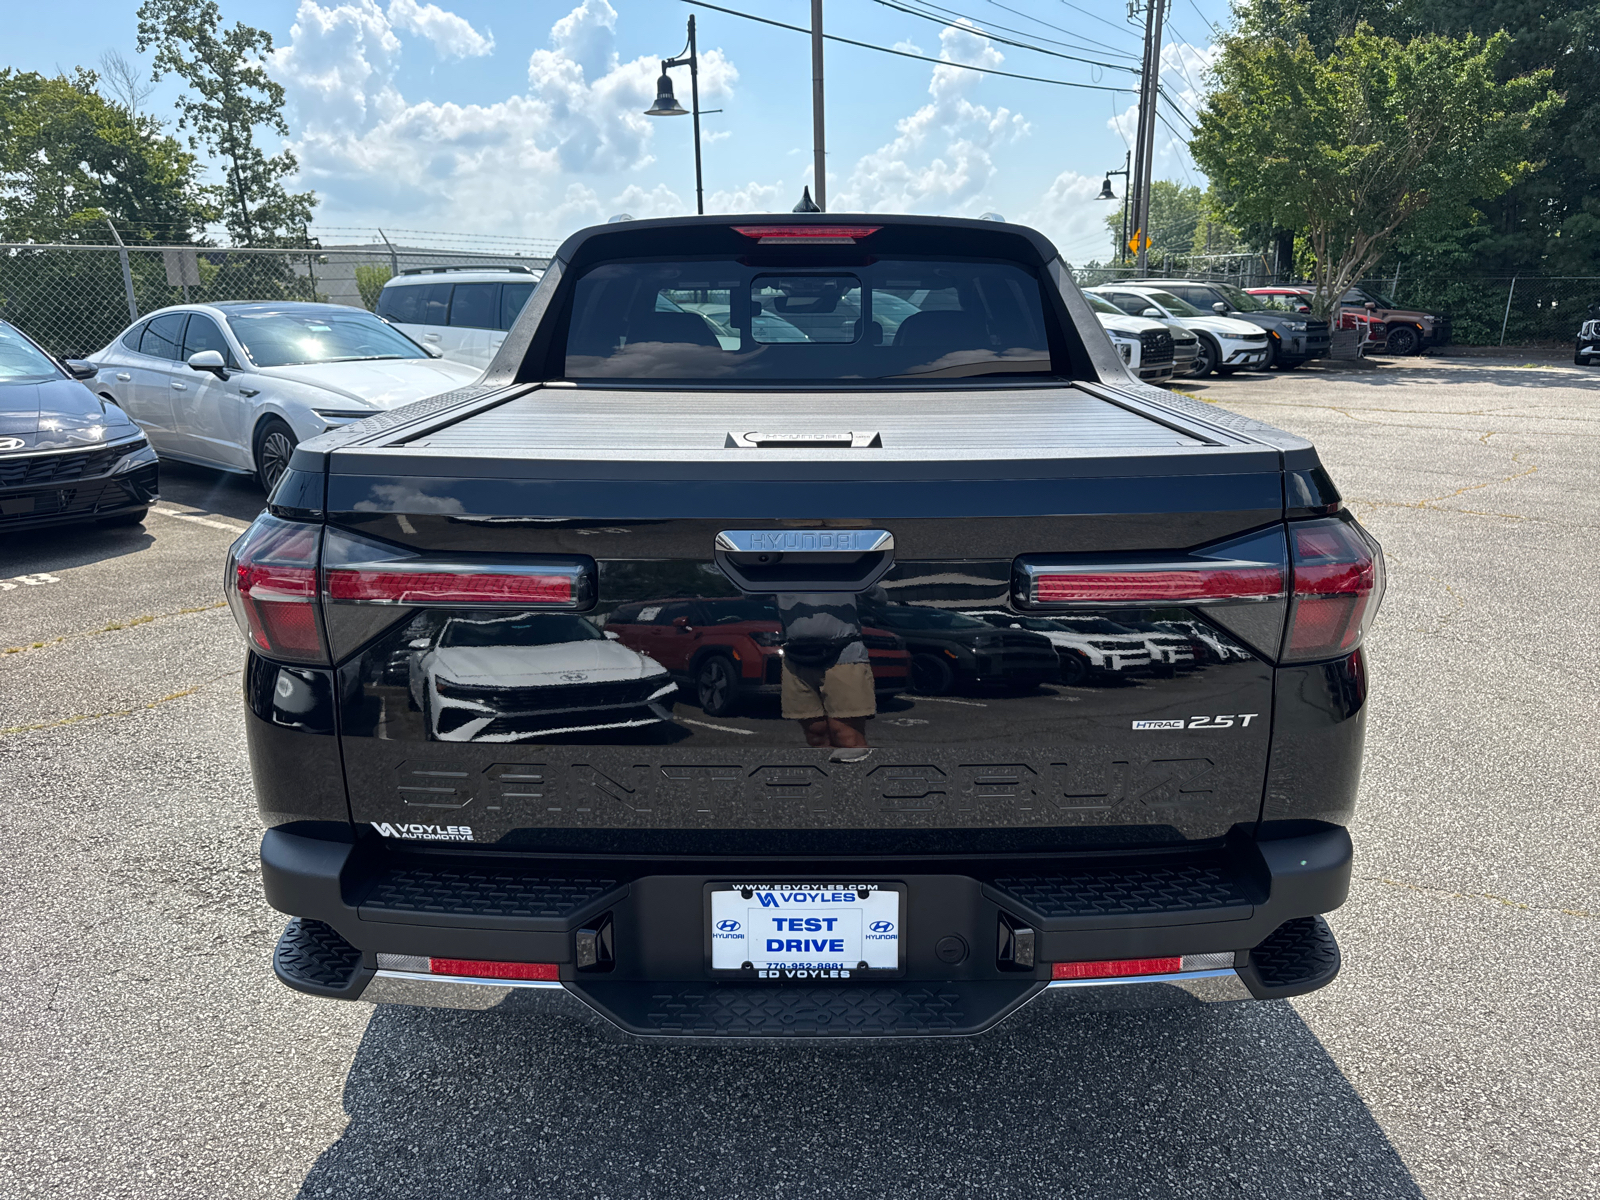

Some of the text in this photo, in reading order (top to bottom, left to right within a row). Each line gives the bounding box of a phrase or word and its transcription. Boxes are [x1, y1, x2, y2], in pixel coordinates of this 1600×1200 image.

[750, 532, 860, 550] HYUNDAI
[1135, 721, 1181, 729] HTRAC
[395, 757, 1215, 815] SANTA CRUZ
[395, 823, 473, 834] VOYLES
[401, 832, 475, 841] AUTOMOTIVE
[780, 892, 856, 903] VOYLES
[772, 917, 838, 932] TEST
[766, 939, 845, 953] DRIVE
[766, 962, 844, 970] 770-952-8881
[758, 970, 851, 979] ED VOYLES
